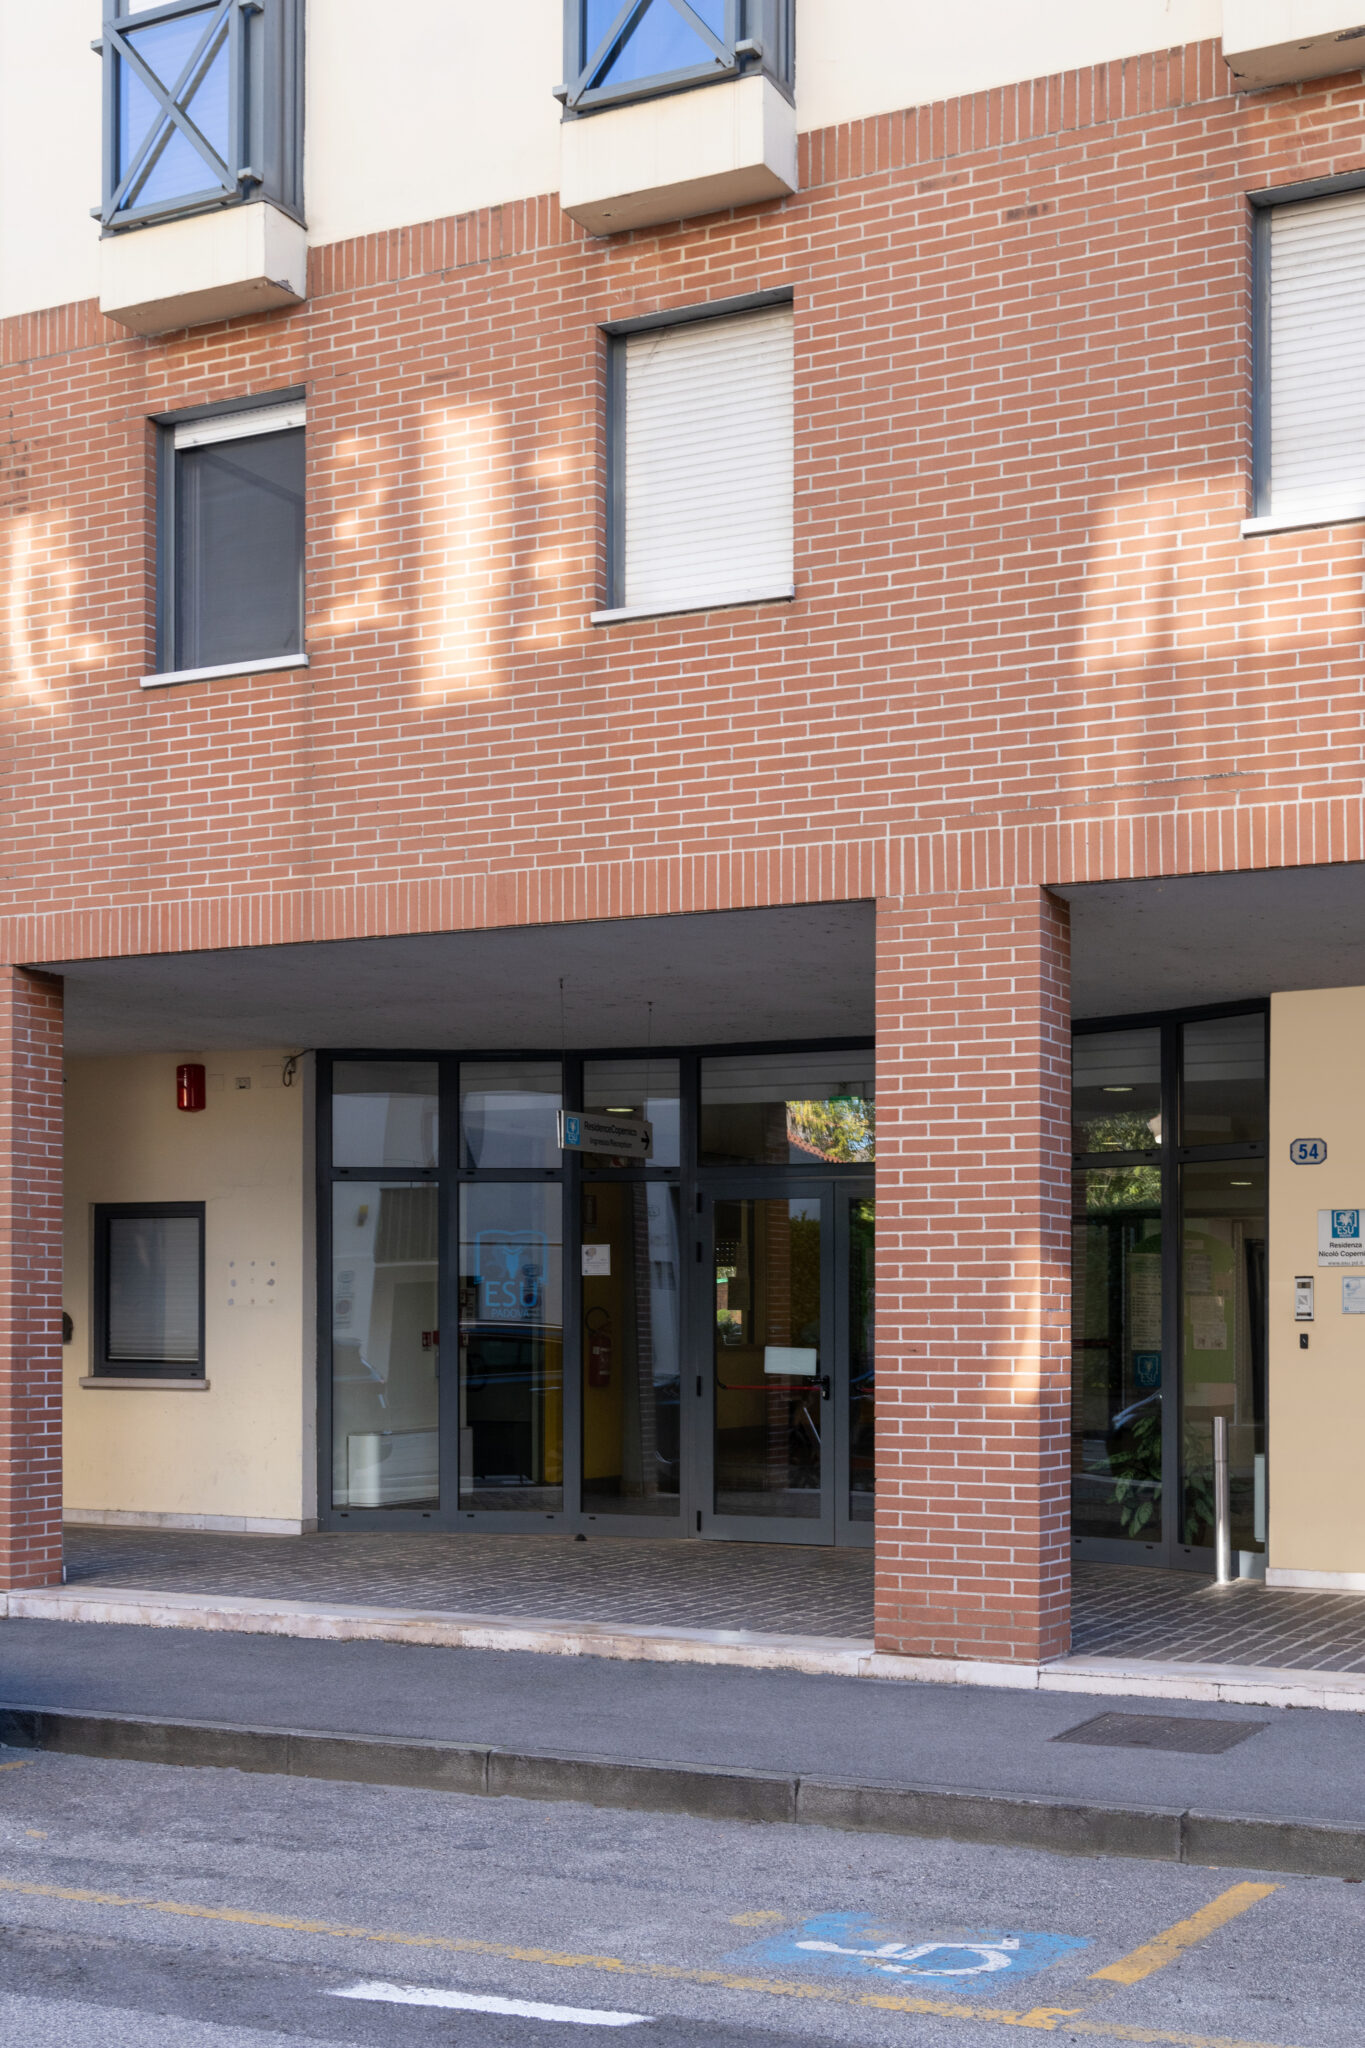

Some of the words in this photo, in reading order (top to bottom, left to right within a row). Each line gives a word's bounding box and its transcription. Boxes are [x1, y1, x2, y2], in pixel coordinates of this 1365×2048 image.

[1298, 1143, 1319, 1160] 54
[1337, 1226, 1354, 1235] ESU
[485, 1281, 538, 1307] ESU
[491, 1308, 530, 1318] PADOVA
